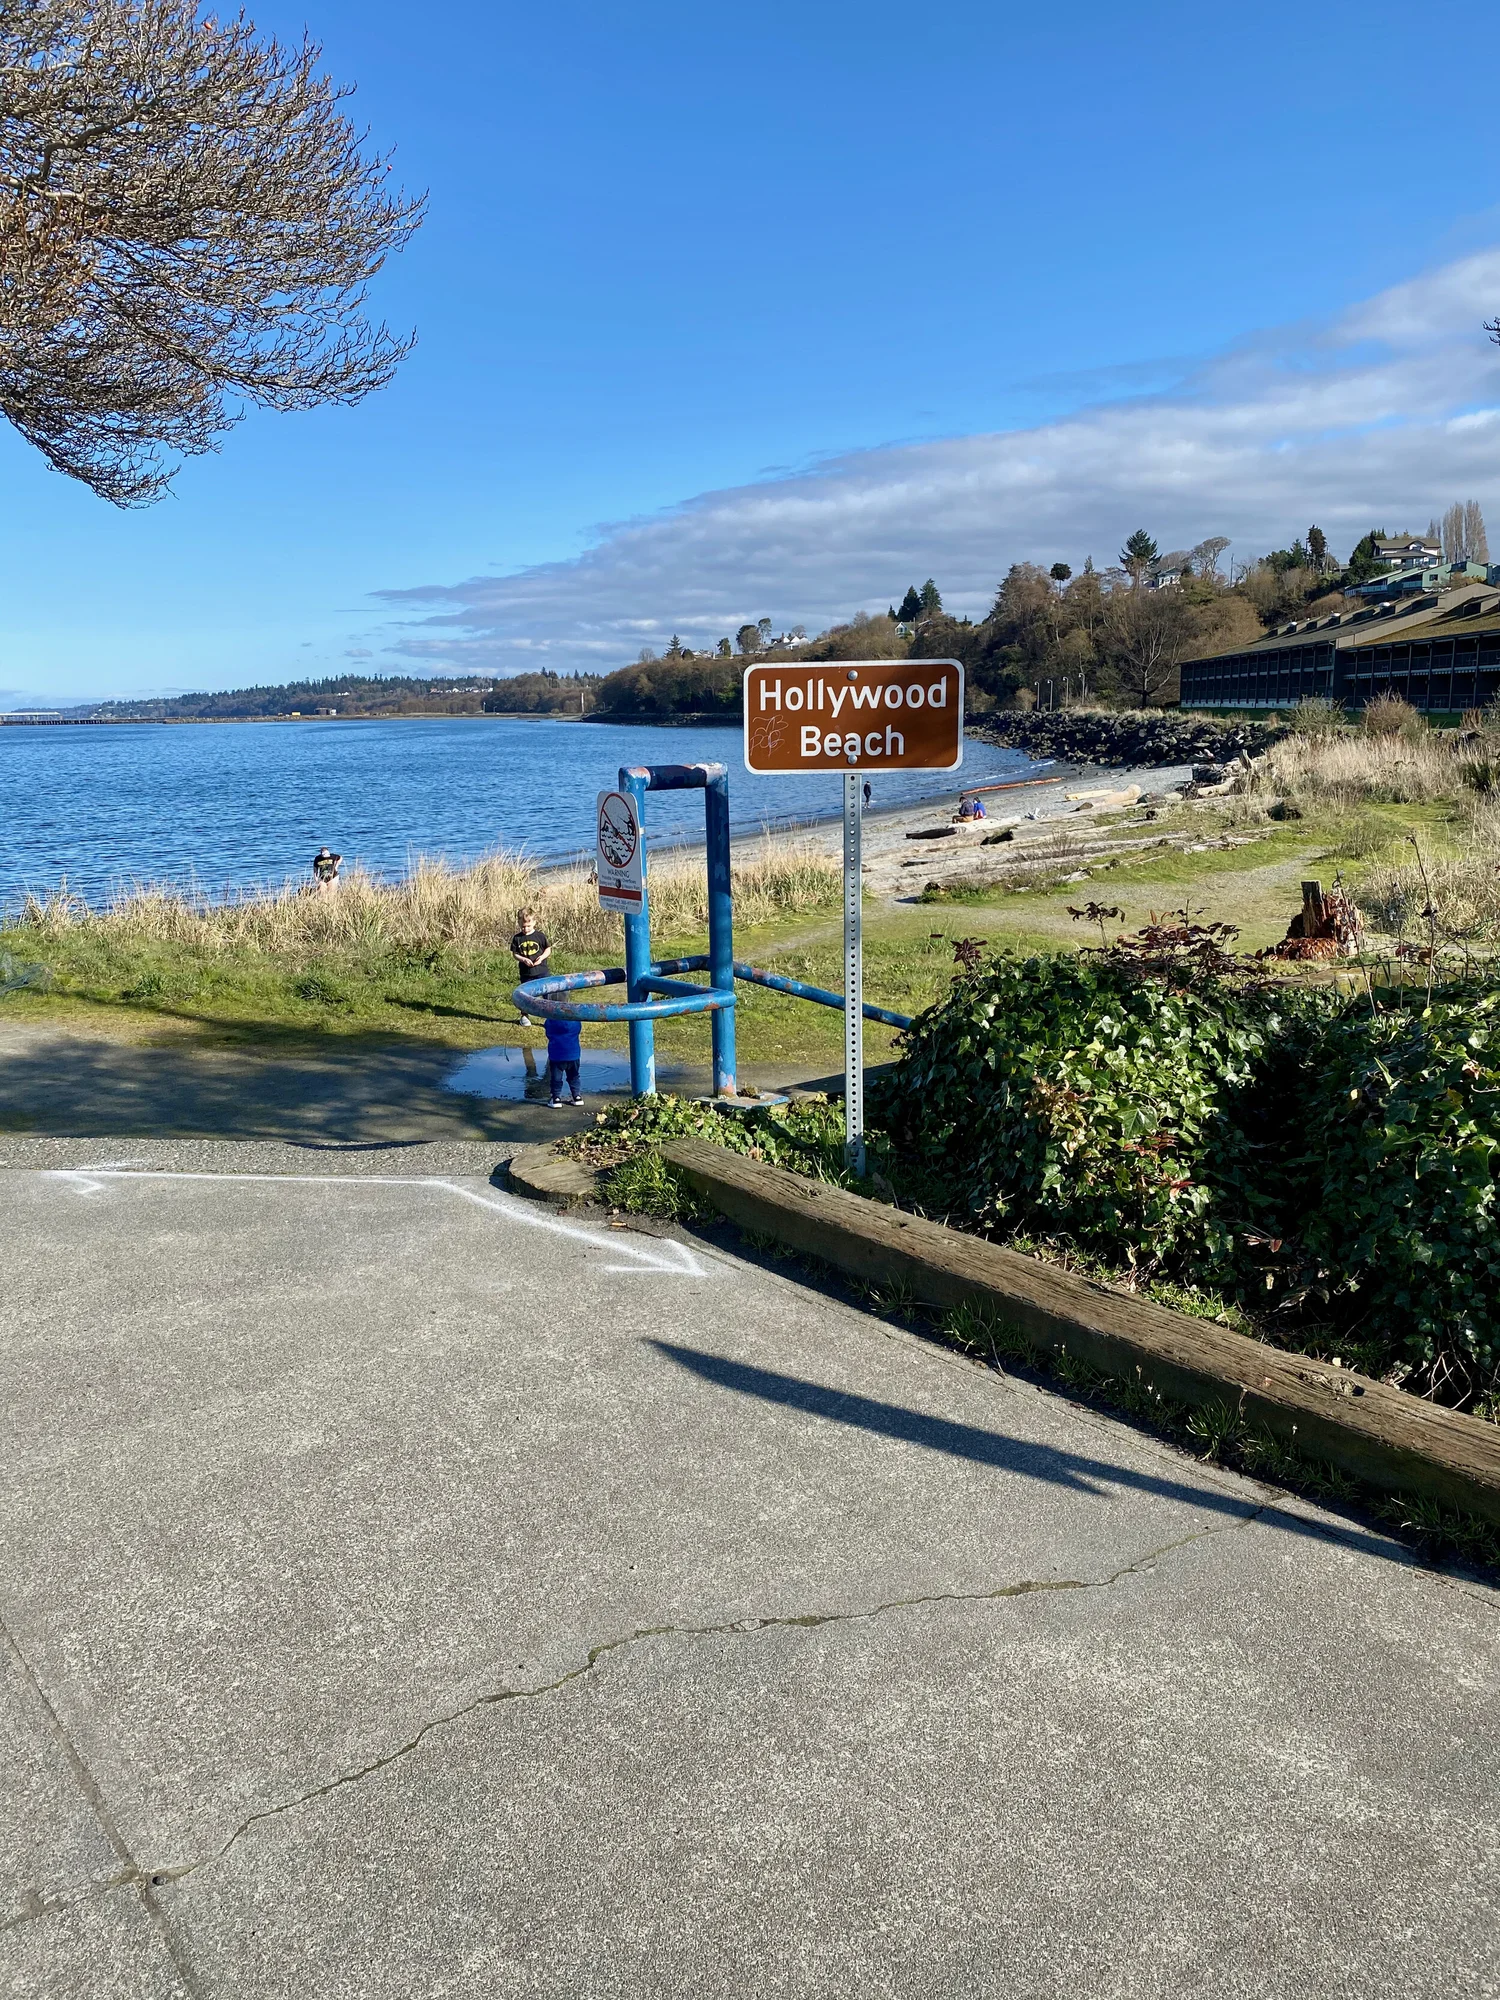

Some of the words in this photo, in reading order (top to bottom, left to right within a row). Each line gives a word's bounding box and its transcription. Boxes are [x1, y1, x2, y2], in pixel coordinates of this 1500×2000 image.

[760, 675, 947, 718] Hollywood
[800, 724, 905, 757] Beach
[607, 868, 630, 878] WARNING
